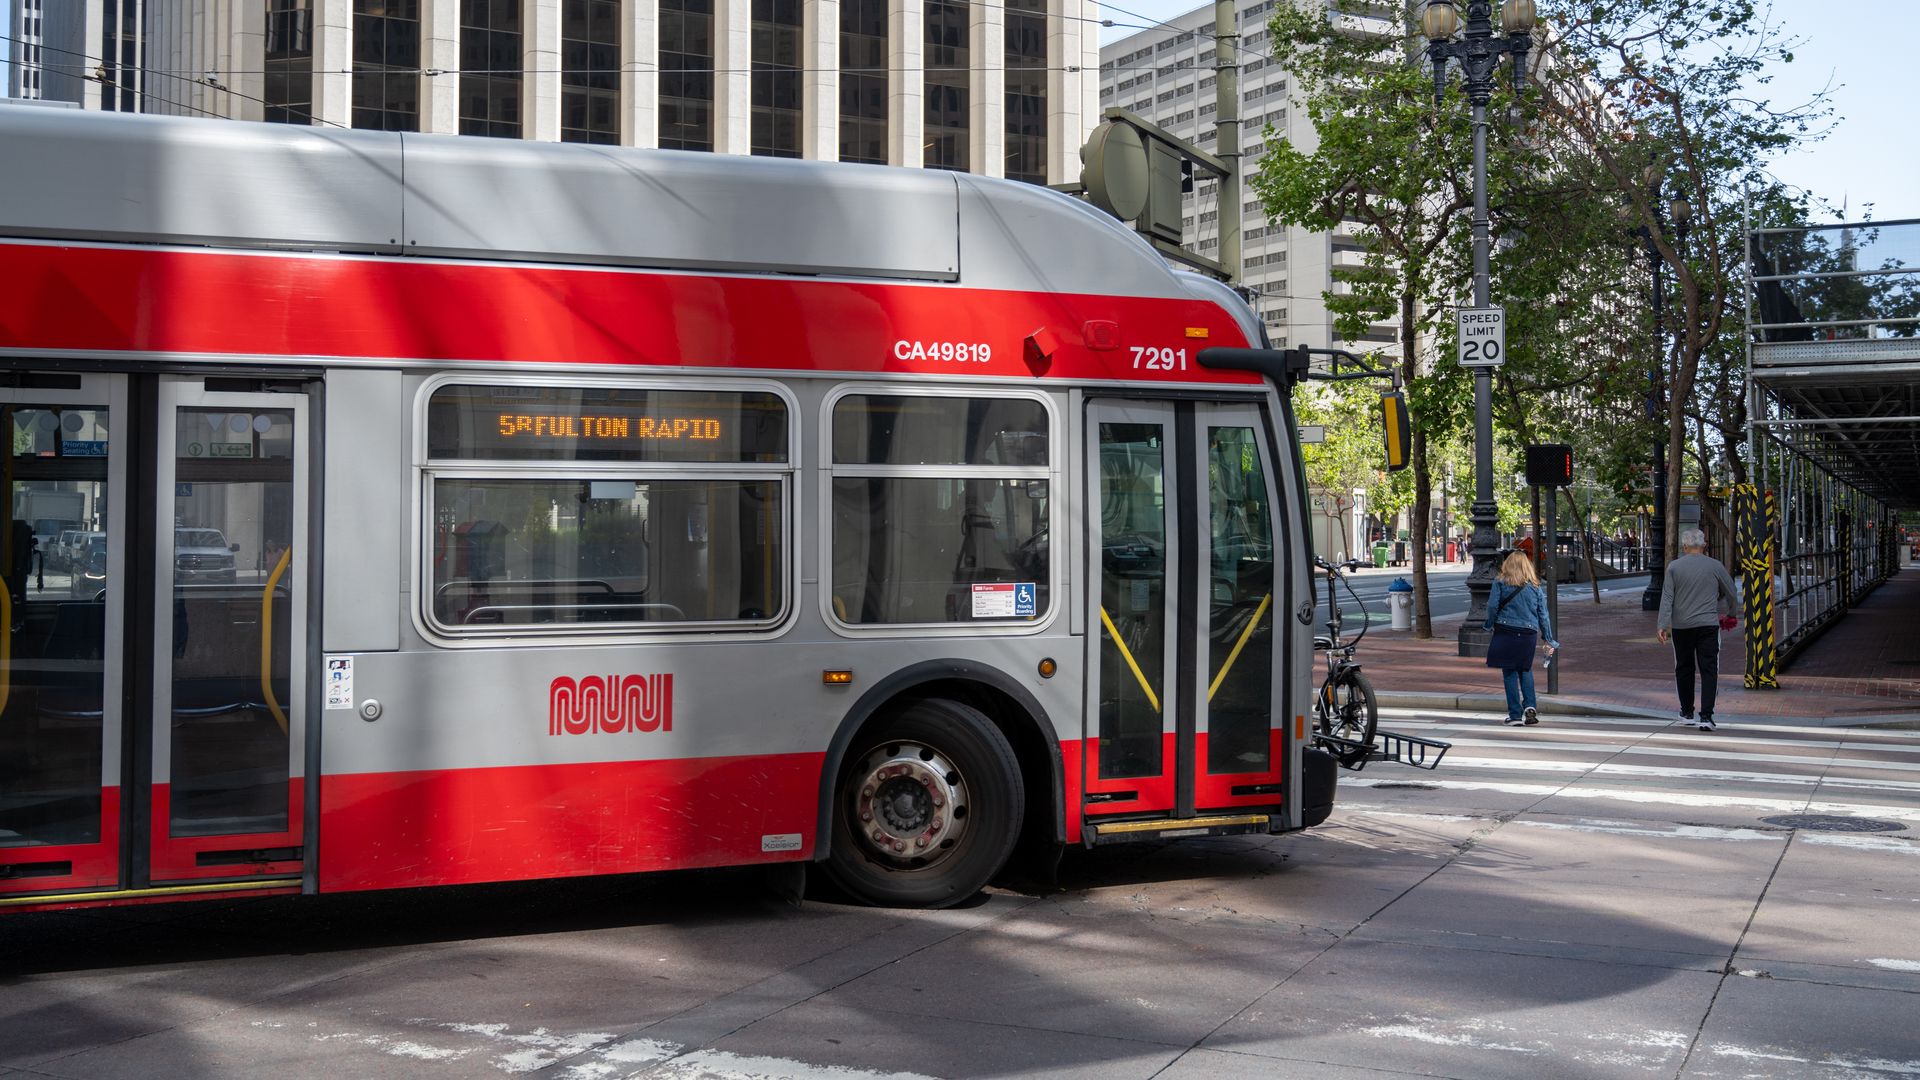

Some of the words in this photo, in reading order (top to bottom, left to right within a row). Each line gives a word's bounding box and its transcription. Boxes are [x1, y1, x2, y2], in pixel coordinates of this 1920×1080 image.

[1462, 314, 1500, 323] SPEED
[1466, 327, 1495, 336] LIMIT
[894, 340, 991, 362] CA49819
[1130, 346, 1187, 370] 7291
[1463, 340, 1499, 360] 20
[640, 418, 720, 439] RAPID
